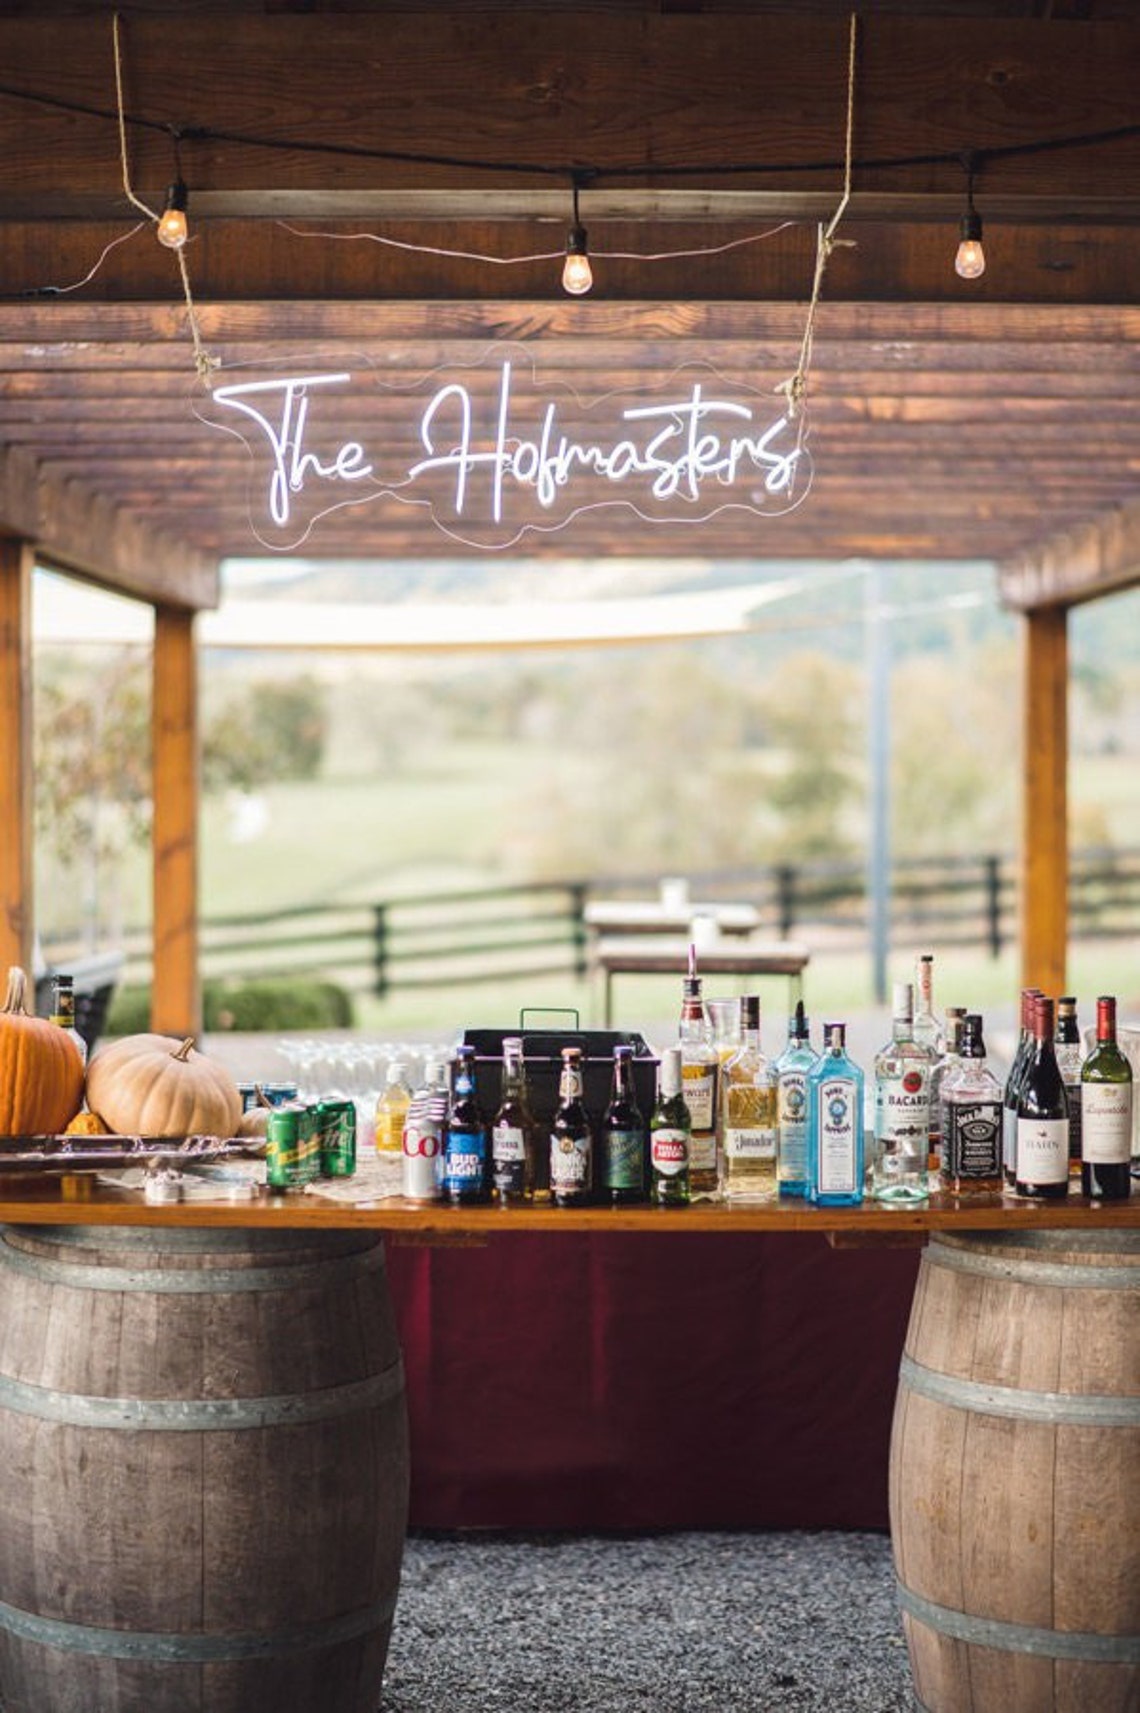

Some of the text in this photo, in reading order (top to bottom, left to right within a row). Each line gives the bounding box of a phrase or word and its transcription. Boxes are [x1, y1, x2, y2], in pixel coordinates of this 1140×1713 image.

[212, 360, 801, 525] The Hofmasters
[888, 1096, 927, 1106] BACARD
[450, 1153, 479, 1165] BUD
[447, 1163, 483, 1175] LIGHT
